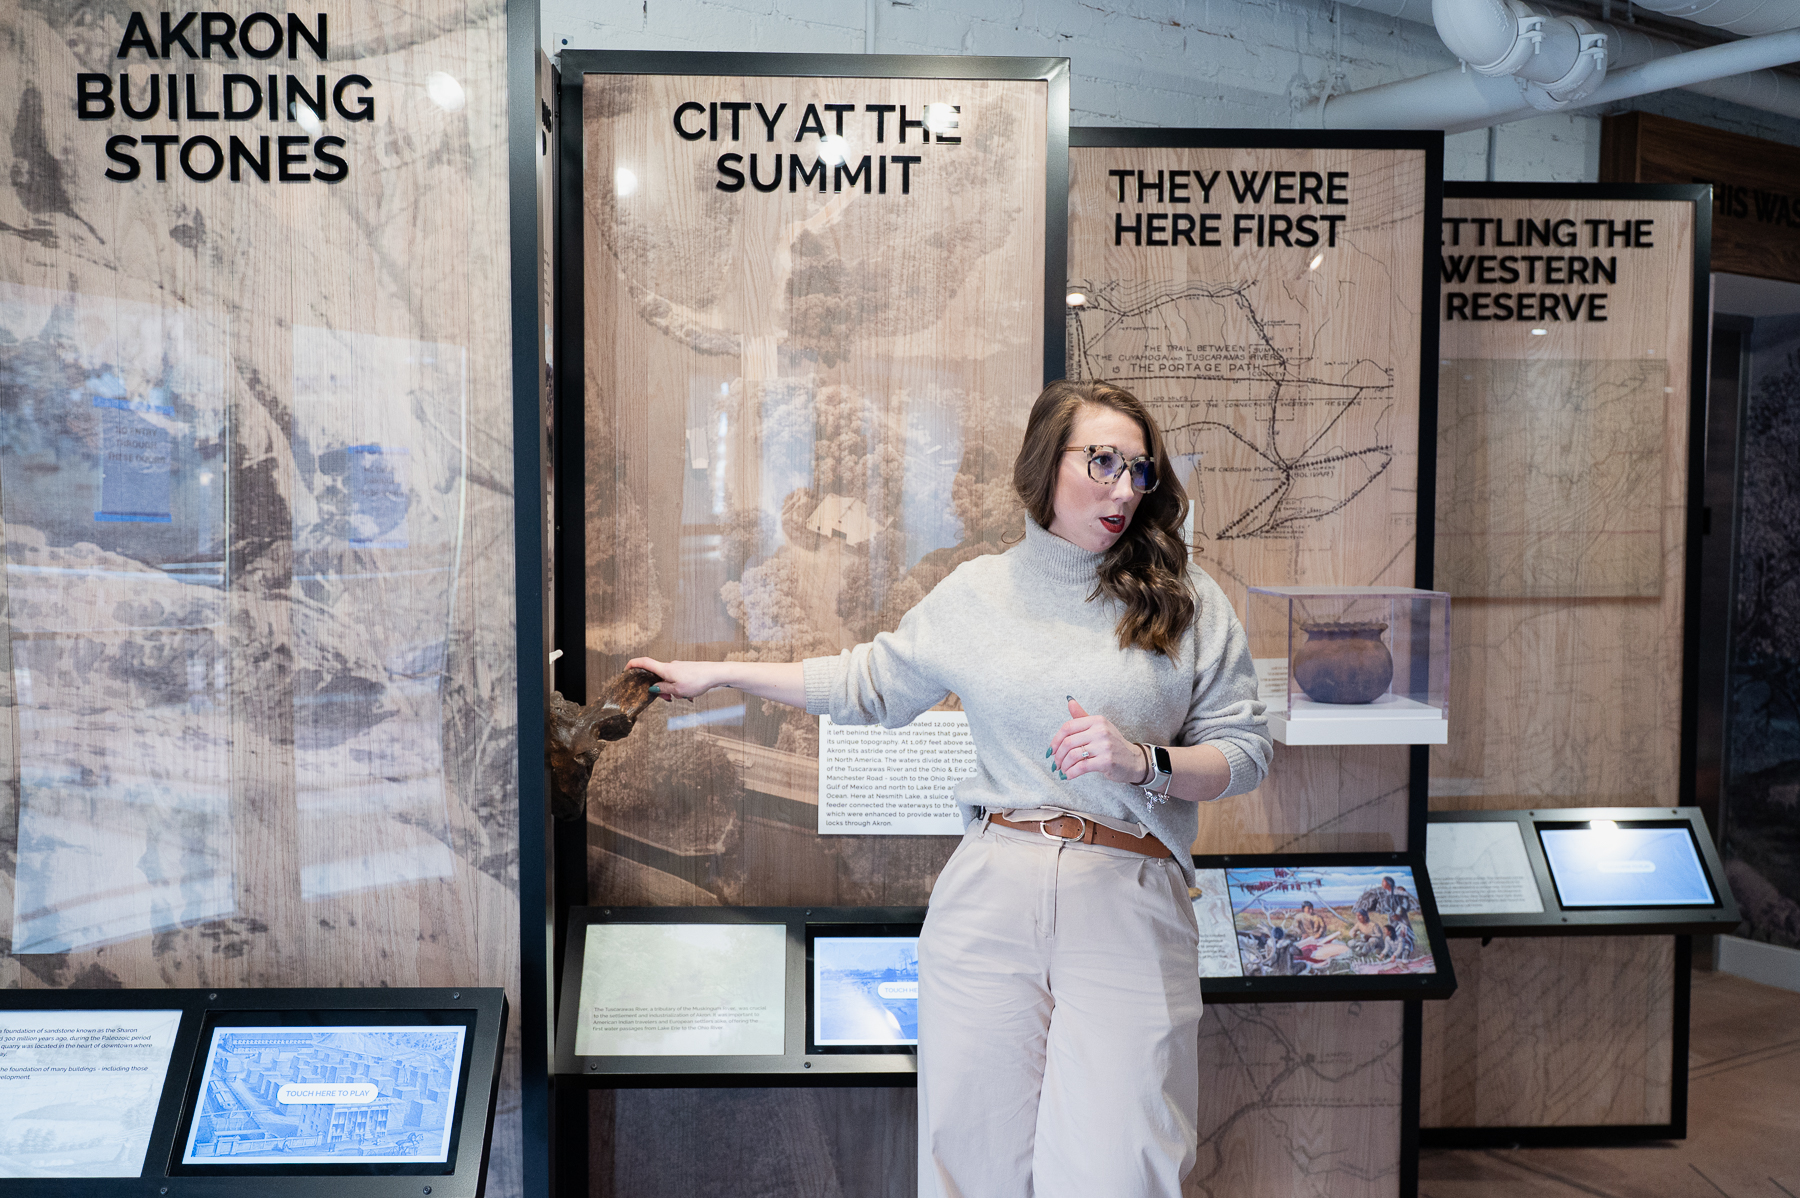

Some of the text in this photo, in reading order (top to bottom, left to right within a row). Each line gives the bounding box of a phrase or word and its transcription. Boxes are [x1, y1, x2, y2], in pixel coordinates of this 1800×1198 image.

[117, 11, 328, 59] AKRON
[77, 73, 375, 121] BUILDING
[673, 101, 962, 145] CITY AT THE
[105, 135, 349, 182] STONES
[716, 153, 922, 194] SUMMIT
[1108, 169, 1349, 205] THEY WERE
[1114, 213, 1346, 248] HERE FIRST
[1584, 219, 1654, 248] THE
[1441, 255, 1617, 285] WESTERN
[1446, 292, 1608, 322] RESERVE
[1130, 363, 1155, 372] THE
[1159, 363, 1221, 372] PORTAGE
[1229, 363, 1261, 372] PATH
